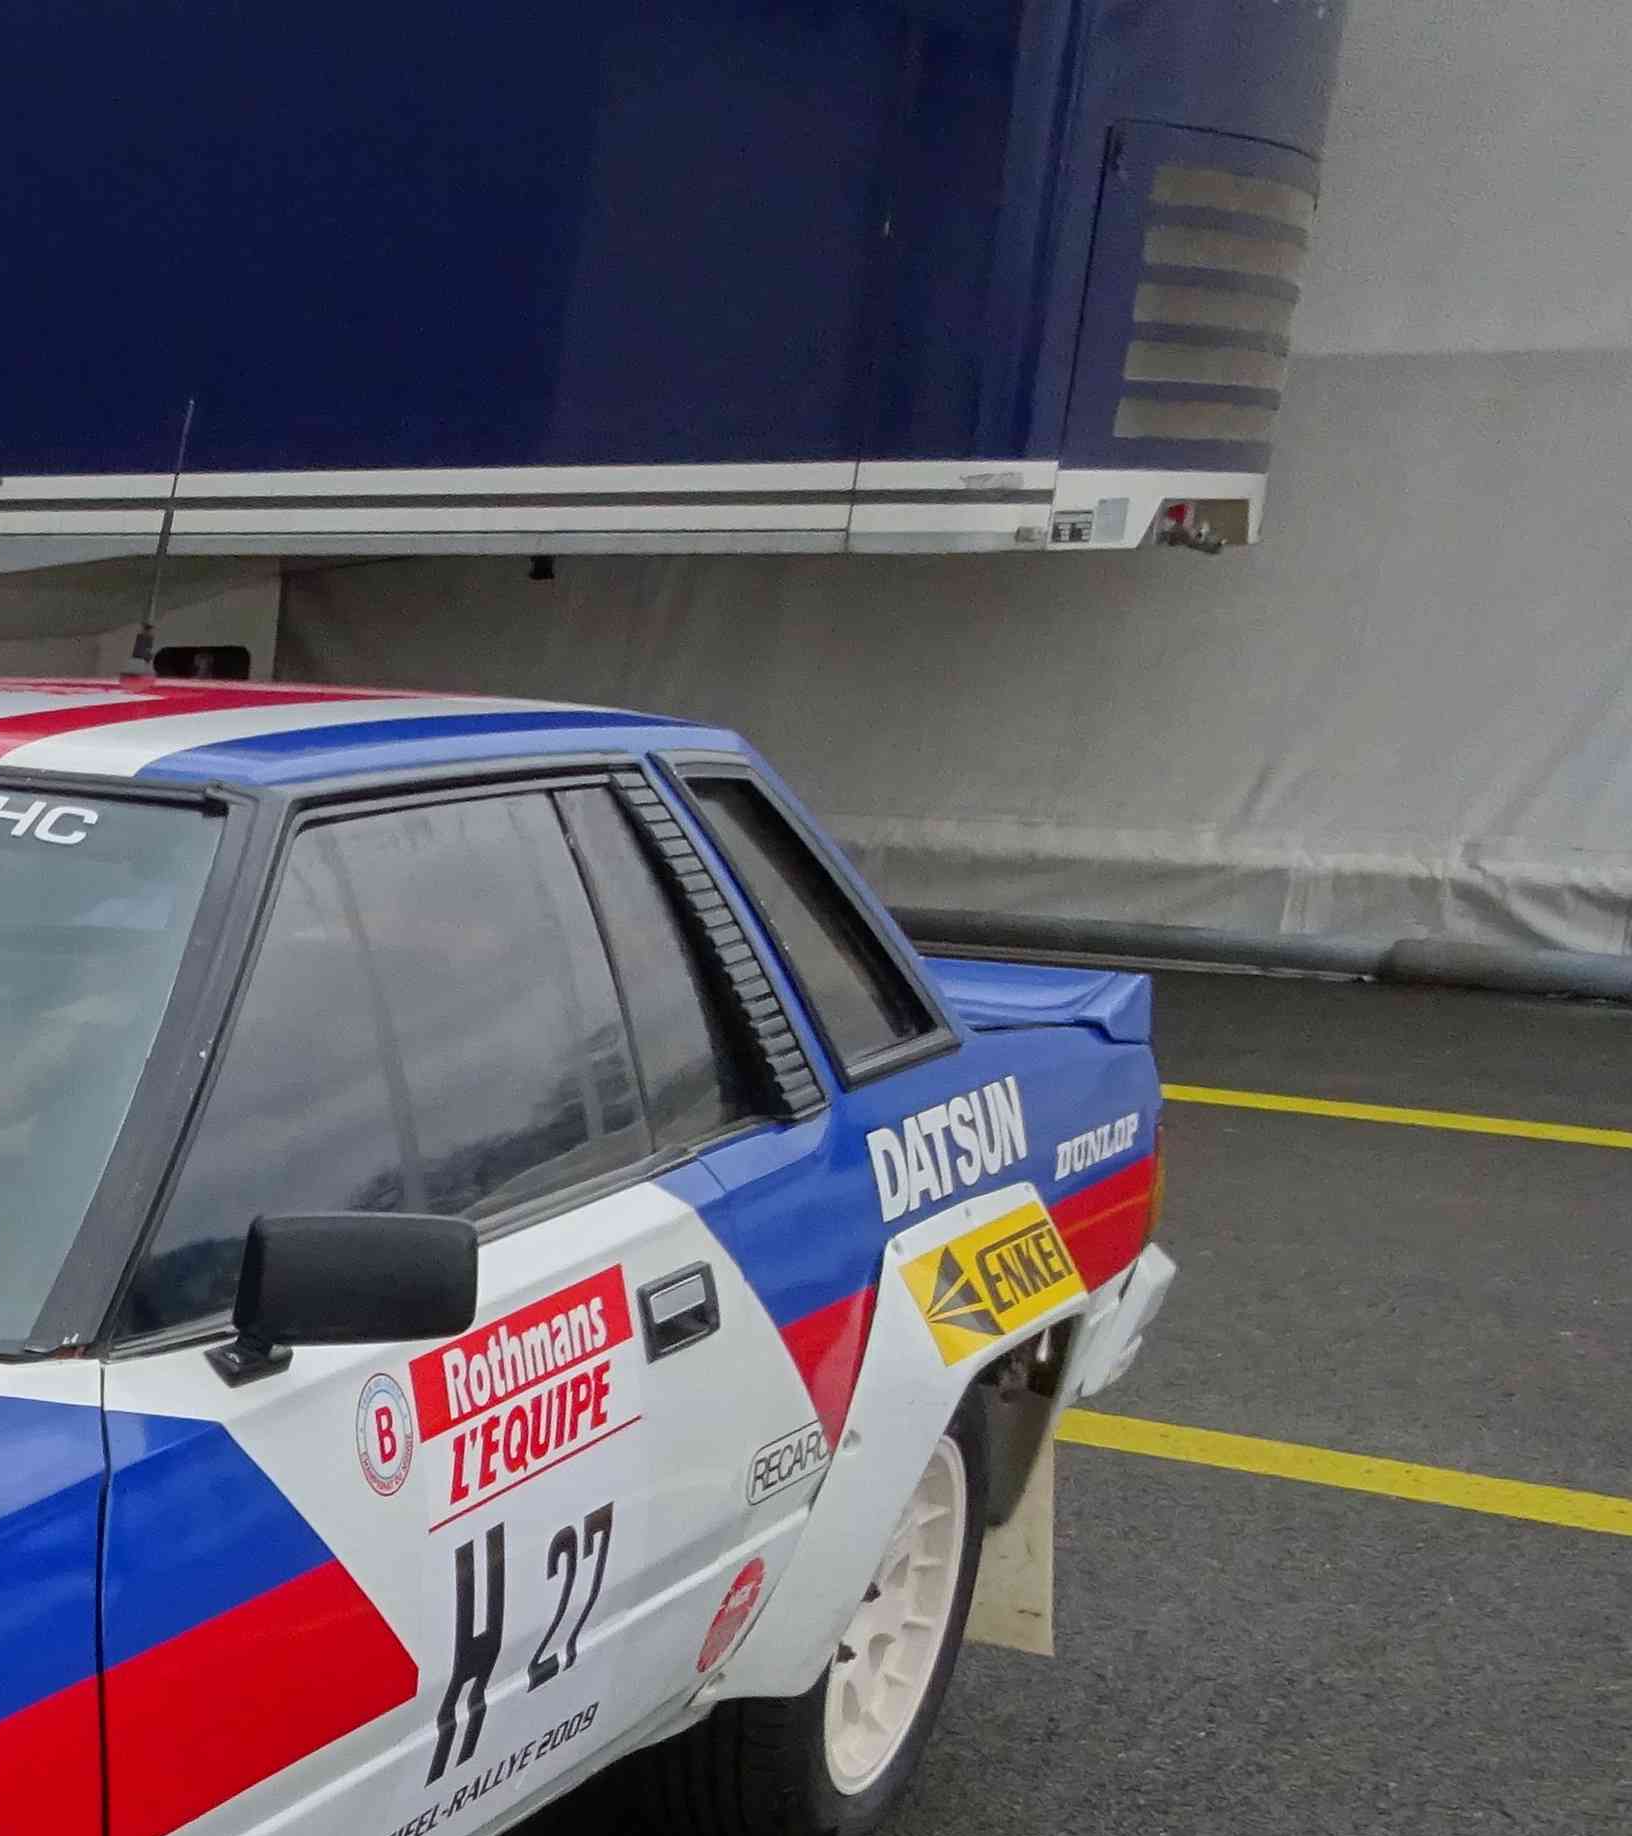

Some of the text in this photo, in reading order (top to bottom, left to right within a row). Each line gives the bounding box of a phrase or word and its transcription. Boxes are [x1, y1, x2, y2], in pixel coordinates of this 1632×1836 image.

[865, 1076, 1028, 1223] DATSUN
[1054, 1113, 1140, 1182] DUNLOP
[976, 1218, 1074, 1314] ENKEI
[442, 1296, 608, 1421] Rothmans
[375, 1406, 397, 1464] B
[449, 1360, 611, 1505] L'EQUIPE
[424, 1501, 614, 1788] H 27
[535, 1701, 600, 1761] 2009
